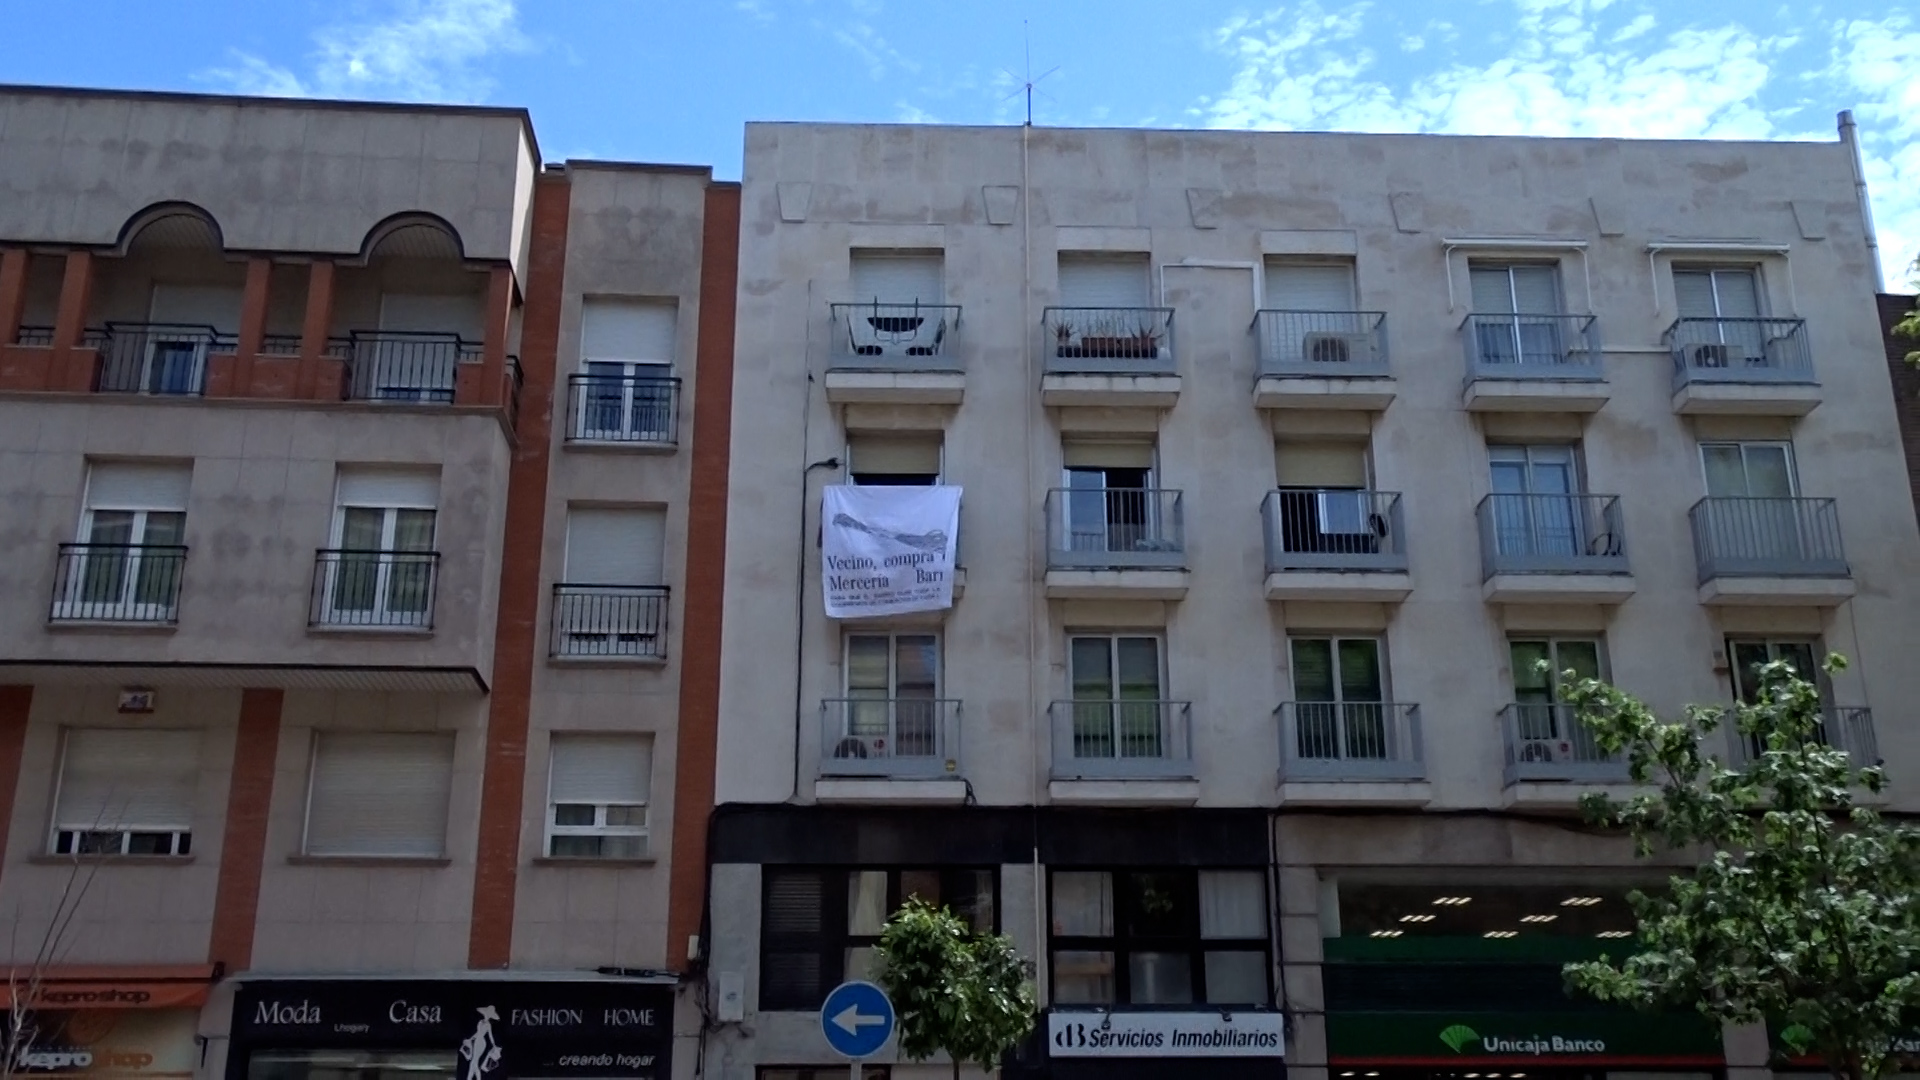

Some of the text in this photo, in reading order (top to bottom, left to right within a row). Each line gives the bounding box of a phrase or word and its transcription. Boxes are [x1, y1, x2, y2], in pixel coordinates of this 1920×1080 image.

[828, 555, 877, 571] Vecino,
[884, 552, 934, 568] compra
[830, 574, 889, 591] Mercería
[253, 999, 443, 1025] Moda Casa
[511, 1009, 655, 1026] FASHION HOME
[1089, 1028, 1164, 1048] Servicios
[1172, 1028, 1278, 1048] Inmobiliarios
[1483, 1034, 1606, 1056] Unicaja Banco
[558, 1053, 656, 1069] creando hogar
